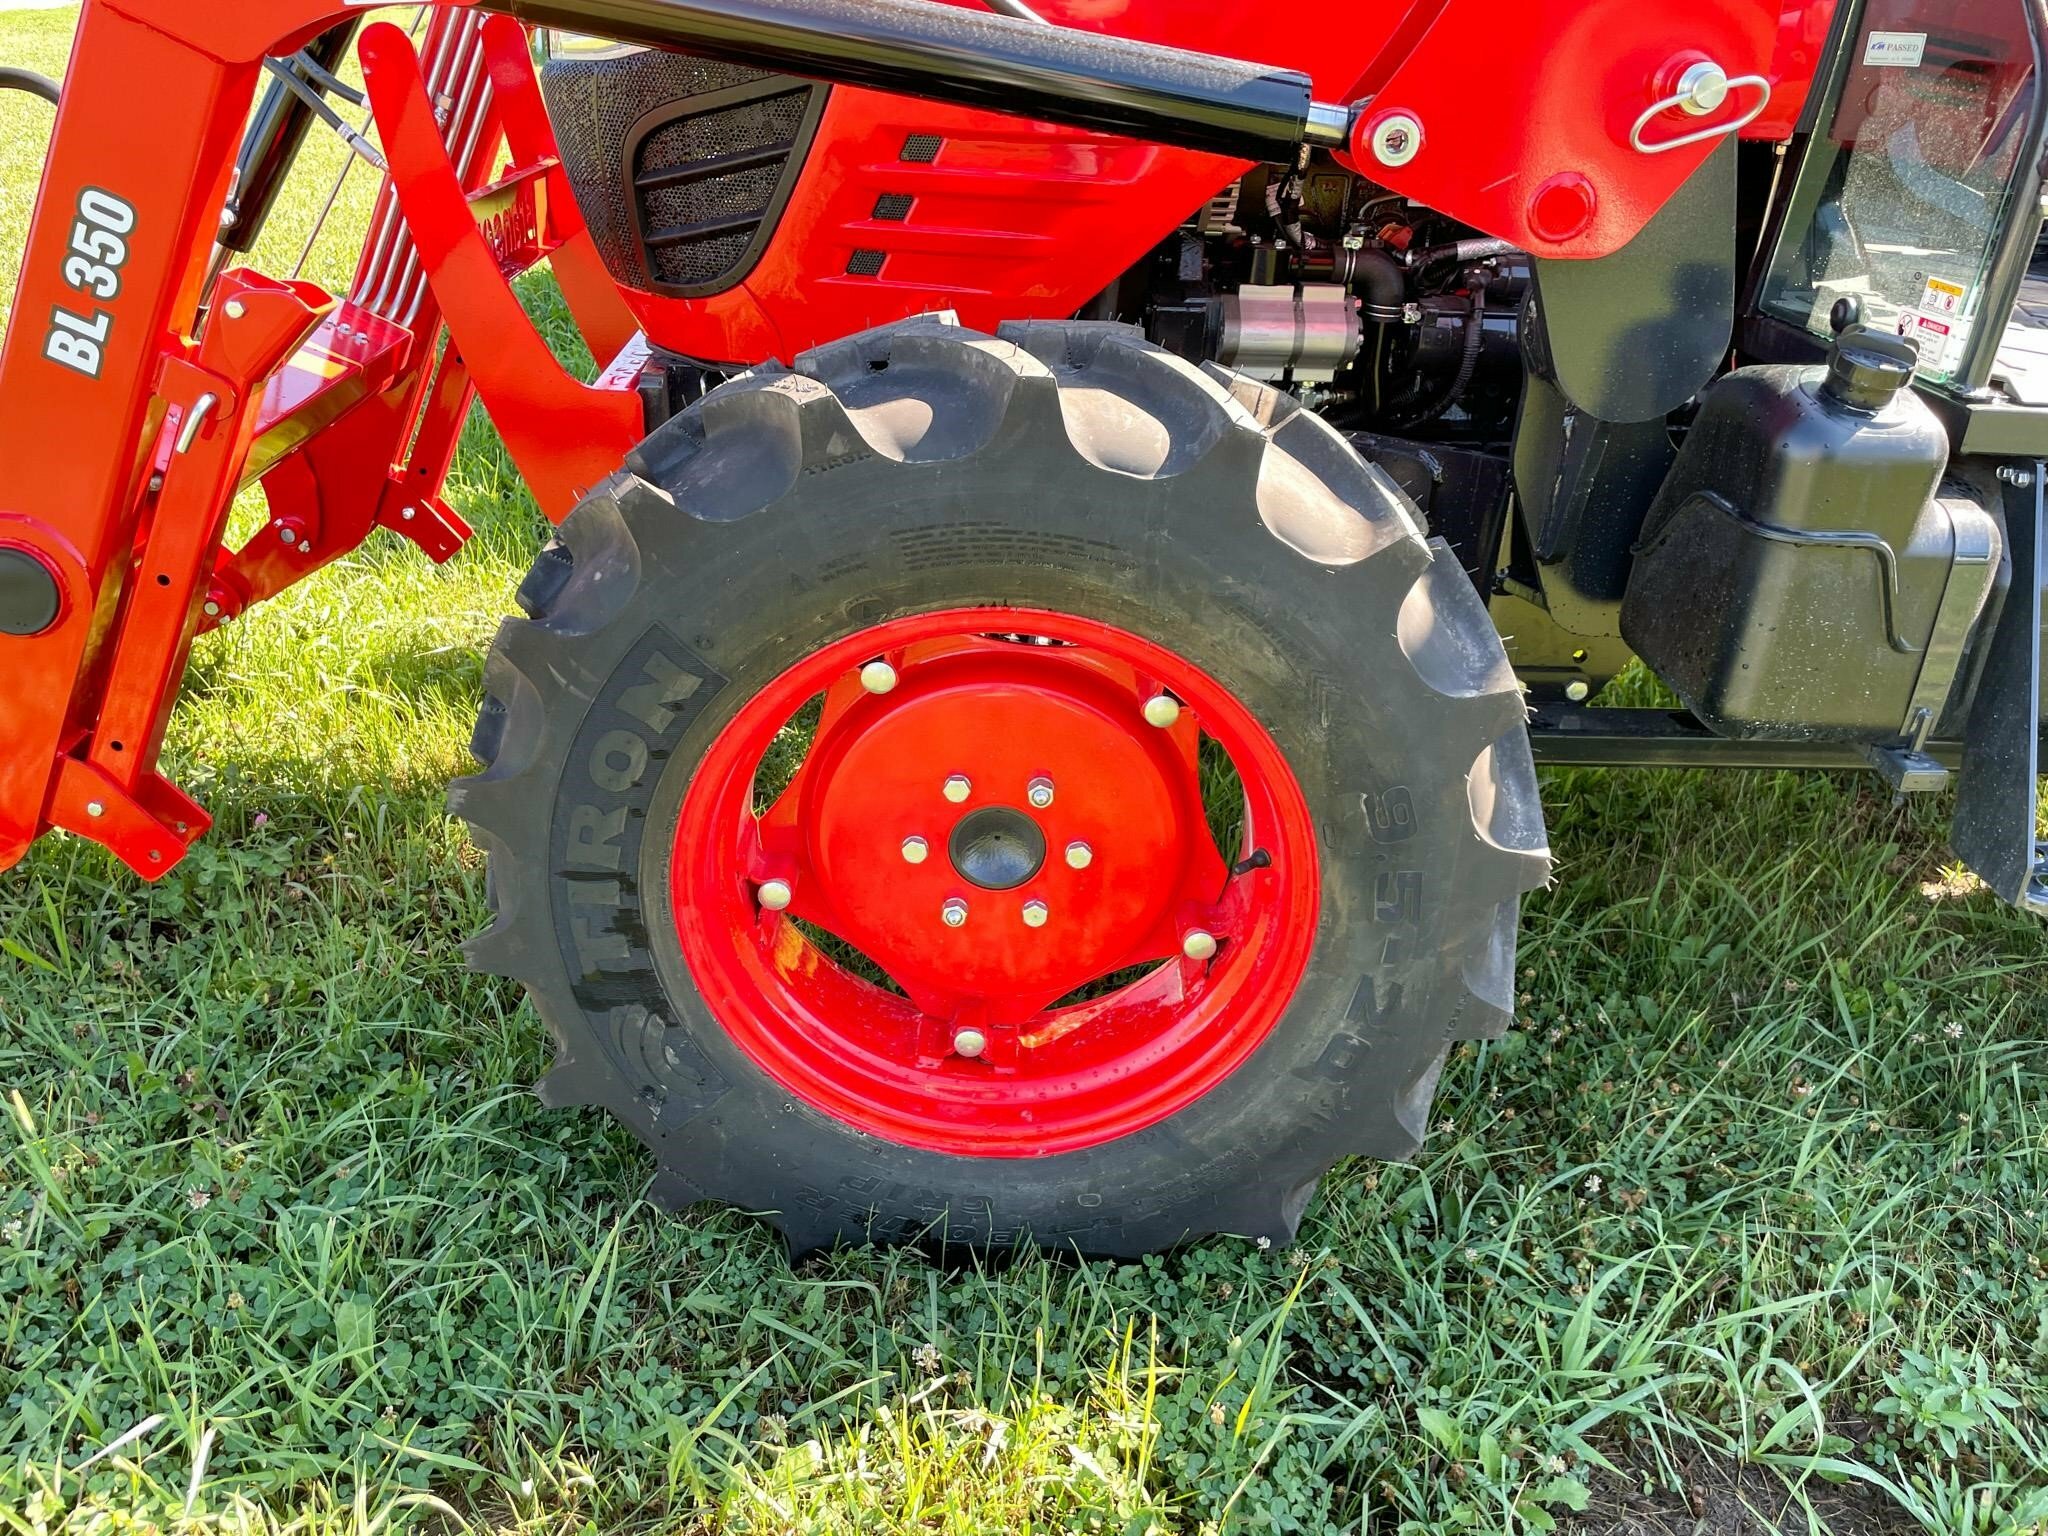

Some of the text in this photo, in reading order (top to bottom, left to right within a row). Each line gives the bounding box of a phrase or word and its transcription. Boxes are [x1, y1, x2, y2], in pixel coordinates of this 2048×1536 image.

[1887, 43, 1919, 53] PASSED
[44, 186, 138, 378] BL 350
[566, 649, 704, 977] TIRON
